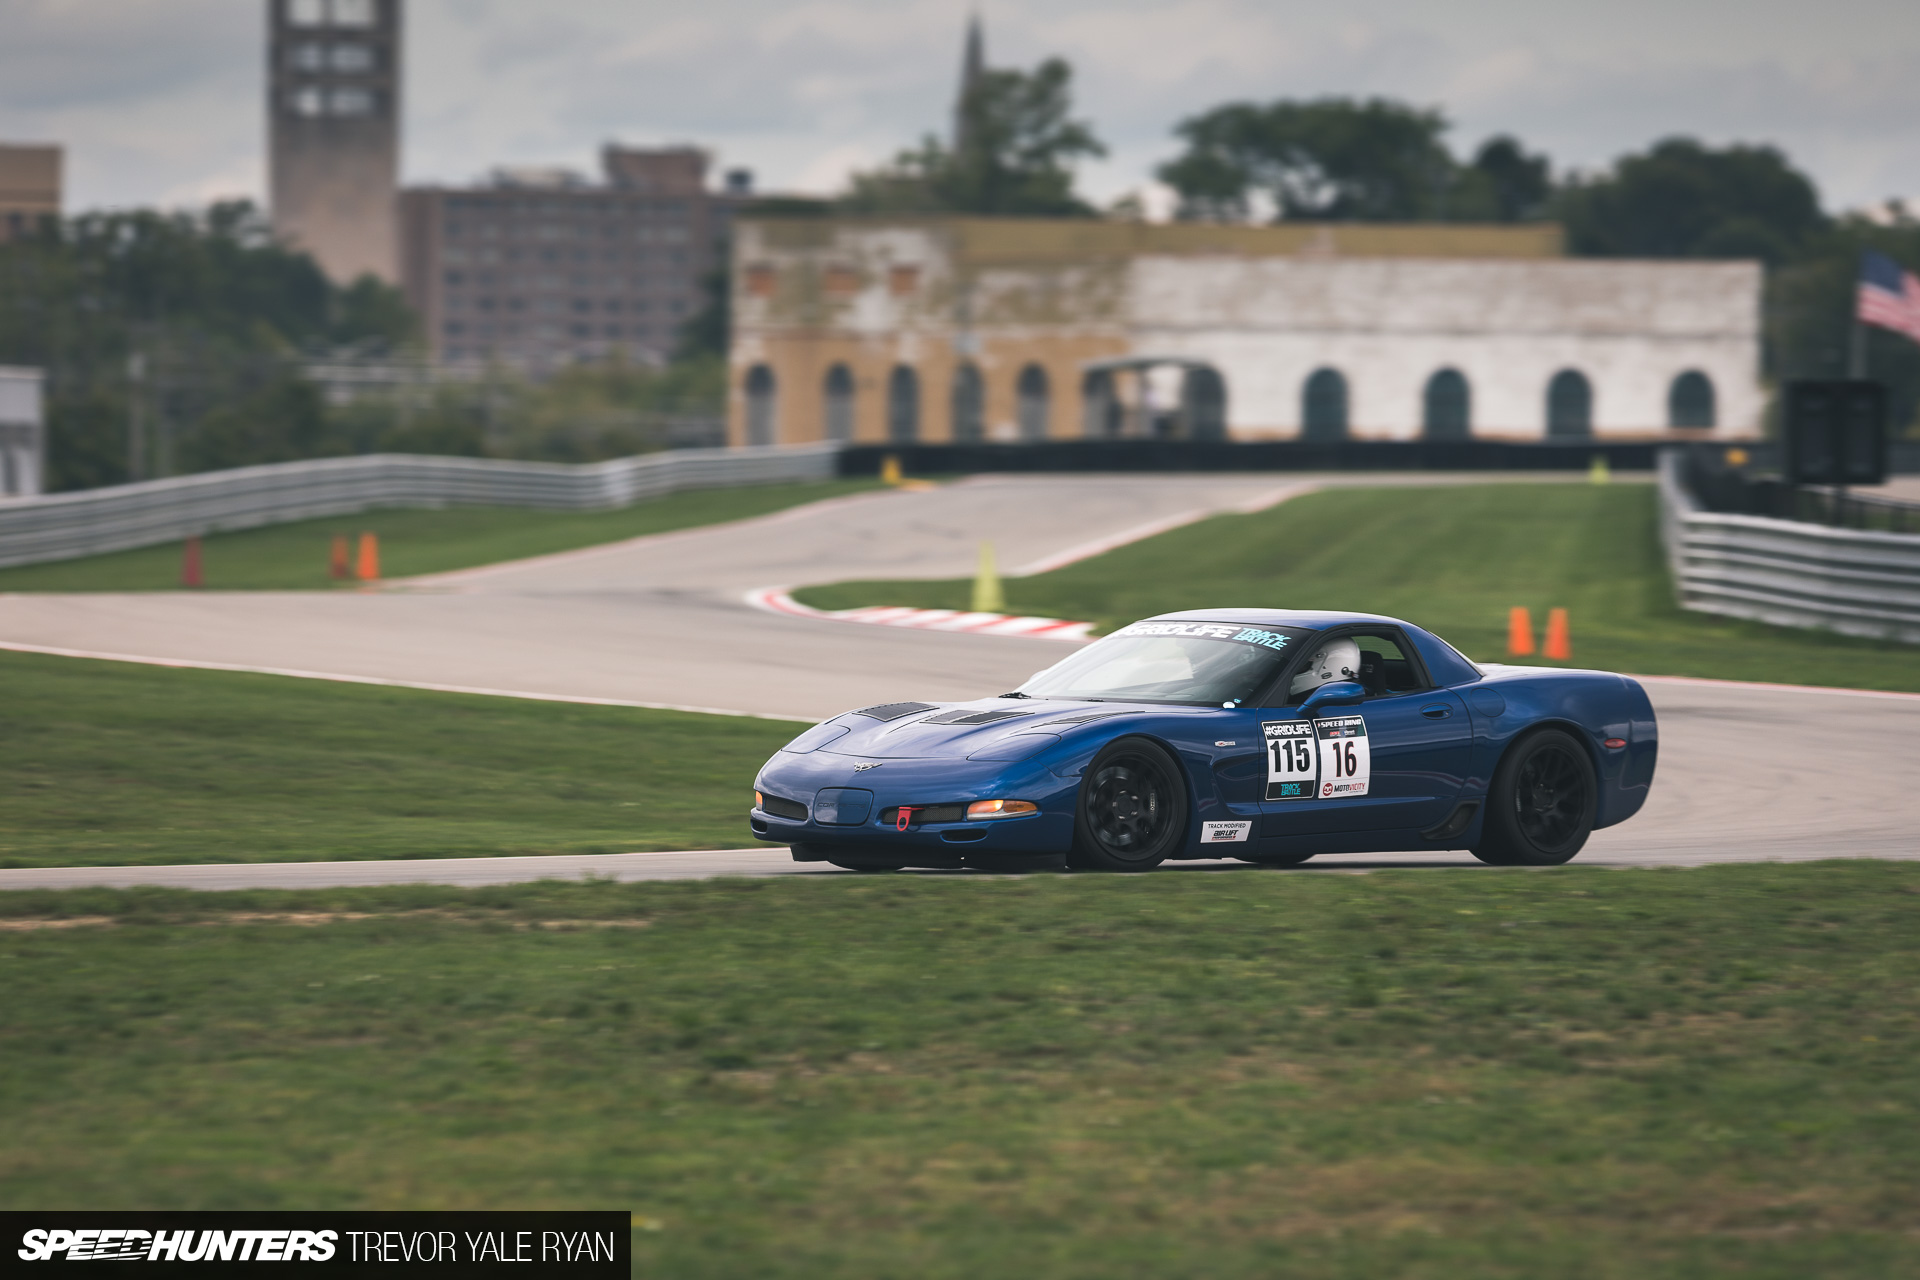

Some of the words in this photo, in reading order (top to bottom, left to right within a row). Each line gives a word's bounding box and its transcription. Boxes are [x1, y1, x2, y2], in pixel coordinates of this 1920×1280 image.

[1231, 634, 1288, 651] BATTLE
[1240, 627, 1292, 642] TRACK
[1265, 724, 1312, 736] #GRIDLIFE
[1270, 740, 1310, 772] 115
[1332, 741, 1356, 778] 16
[1334, 782, 1366, 792] MOTOVICITY
